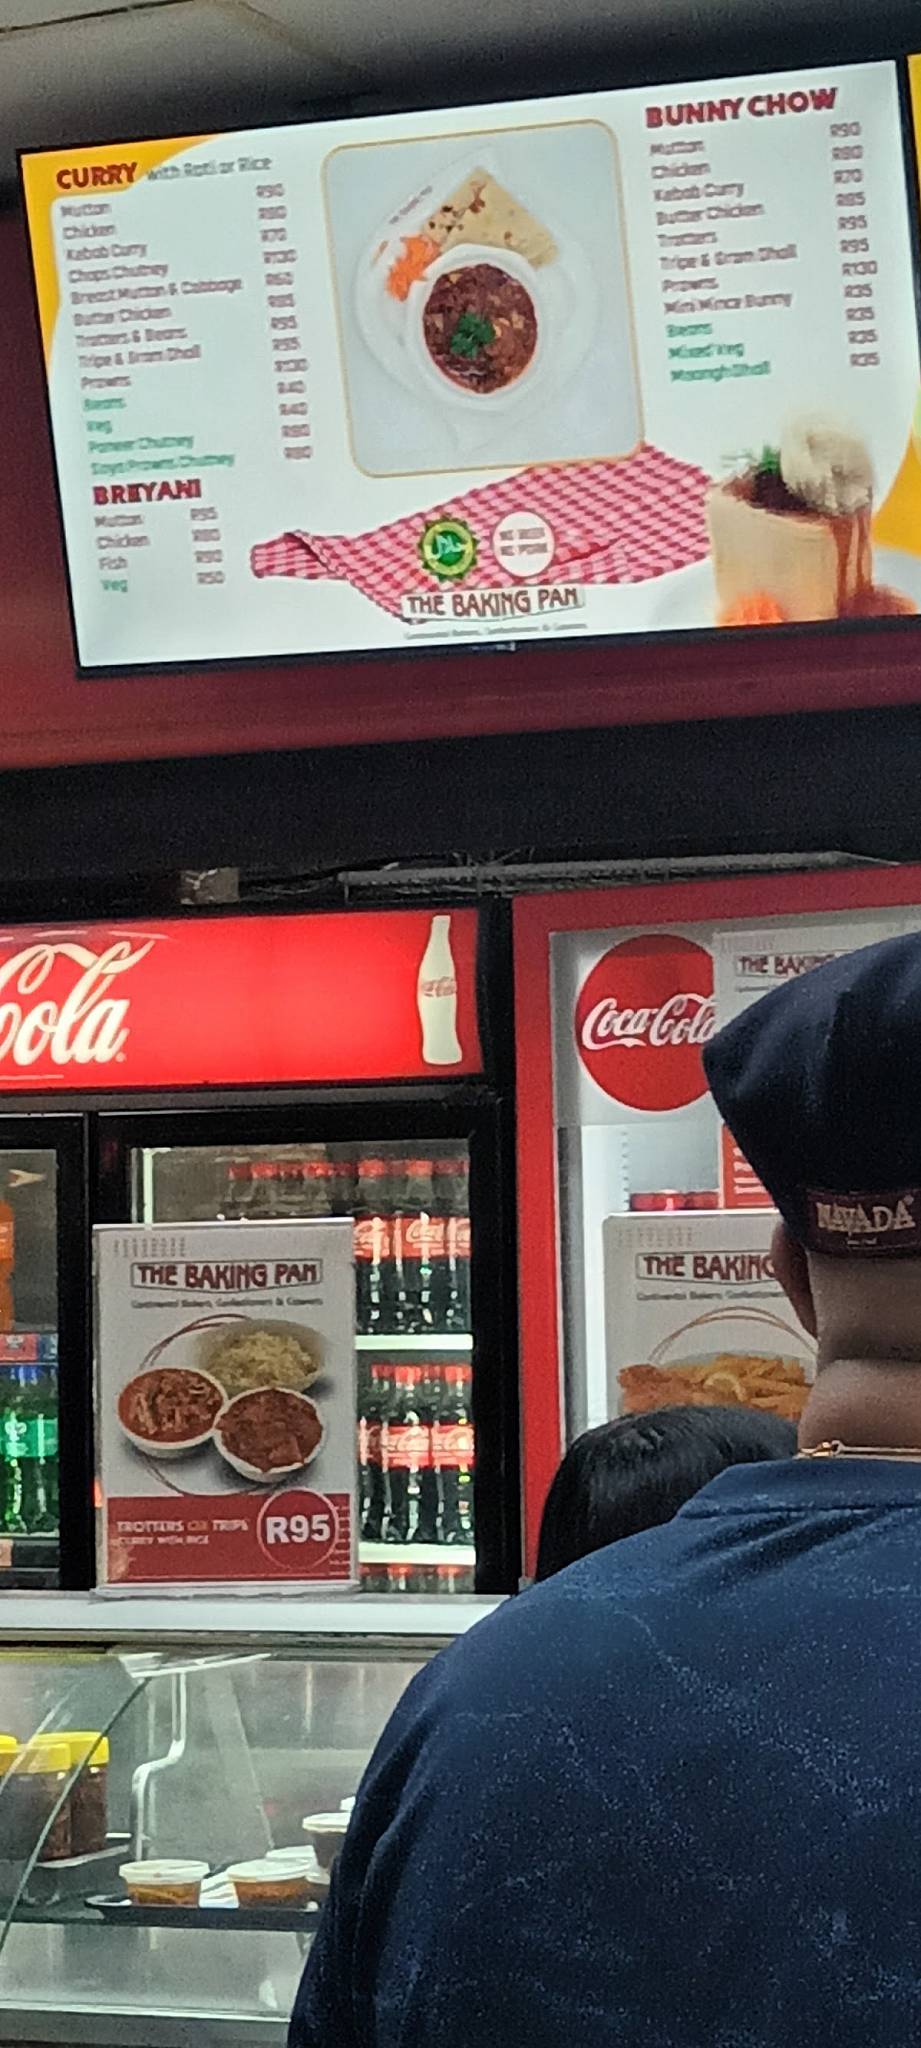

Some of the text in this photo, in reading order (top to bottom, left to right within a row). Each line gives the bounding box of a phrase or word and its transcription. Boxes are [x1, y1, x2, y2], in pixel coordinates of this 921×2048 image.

[645, 87, 838, 128] BUNNY CHOW
[830, 122, 861, 137] R90
[650, 141, 705, 155] Mutton
[832, 145, 863, 161] R80
[56, 157, 272, 189] CURRY with Roti or Rice
[651, 162, 710, 179] Chicken
[833, 169, 863, 184] R70
[654, 183, 744, 202] Kebab Curry
[61, 203, 111, 217] Mutton
[656, 203, 764, 226] Butter Chicken
[838, 215, 867, 230] R95
[63, 224, 116, 239] Chicken
[657, 232, 717, 247] Trotters
[66, 243, 147, 261] Kebab Curry
[840, 238, 869, 253] R95
[660, 256, 697, 270] Tripe
[700, 253, 710, 268] &
[842, 261, 878, 276] R130
[112, 264, 168, 279] Chutney
[118, 285, 164, 299] Mutton
[169, 284, 178, 295] &
[181, 278, 242, 296] Cabbage
[662, 278, 719, 293] Prawns
[699, 297, 742, 311] Mince
[745, 293, 792, 307] Bunny
[74, 307, 171, 326] Butter Chicken
[76, 333, 130, 347] Trotters
[132, 330, 141, 343] &
[666, 323, 713, 338] Beans
[668, 343, 745, 359] Mixed Veg
[79, 354, 112, 369] Tripe
[115, 353, 124, 365] &
[81, 375, 131, 390] Prawns
[93, 478, 202, 505] BREYANI
[95, 514, 143, 527] Mutton
[97, 535, 150, 549] Chicken
[99, 556, 127, 570] Fish
[101, 579, 128, 592] Veg
[407, 587, 578, 617] THE BAKING PAN
[739, 955, 769, 974] THE
[643, 1256, 685, 1276] THE
[138, 1264, 317, 1290] THE BAKING PAN
[117, 1520, 184, 1532] TROTTERS
[266, 1514, 331, 1544] R95
